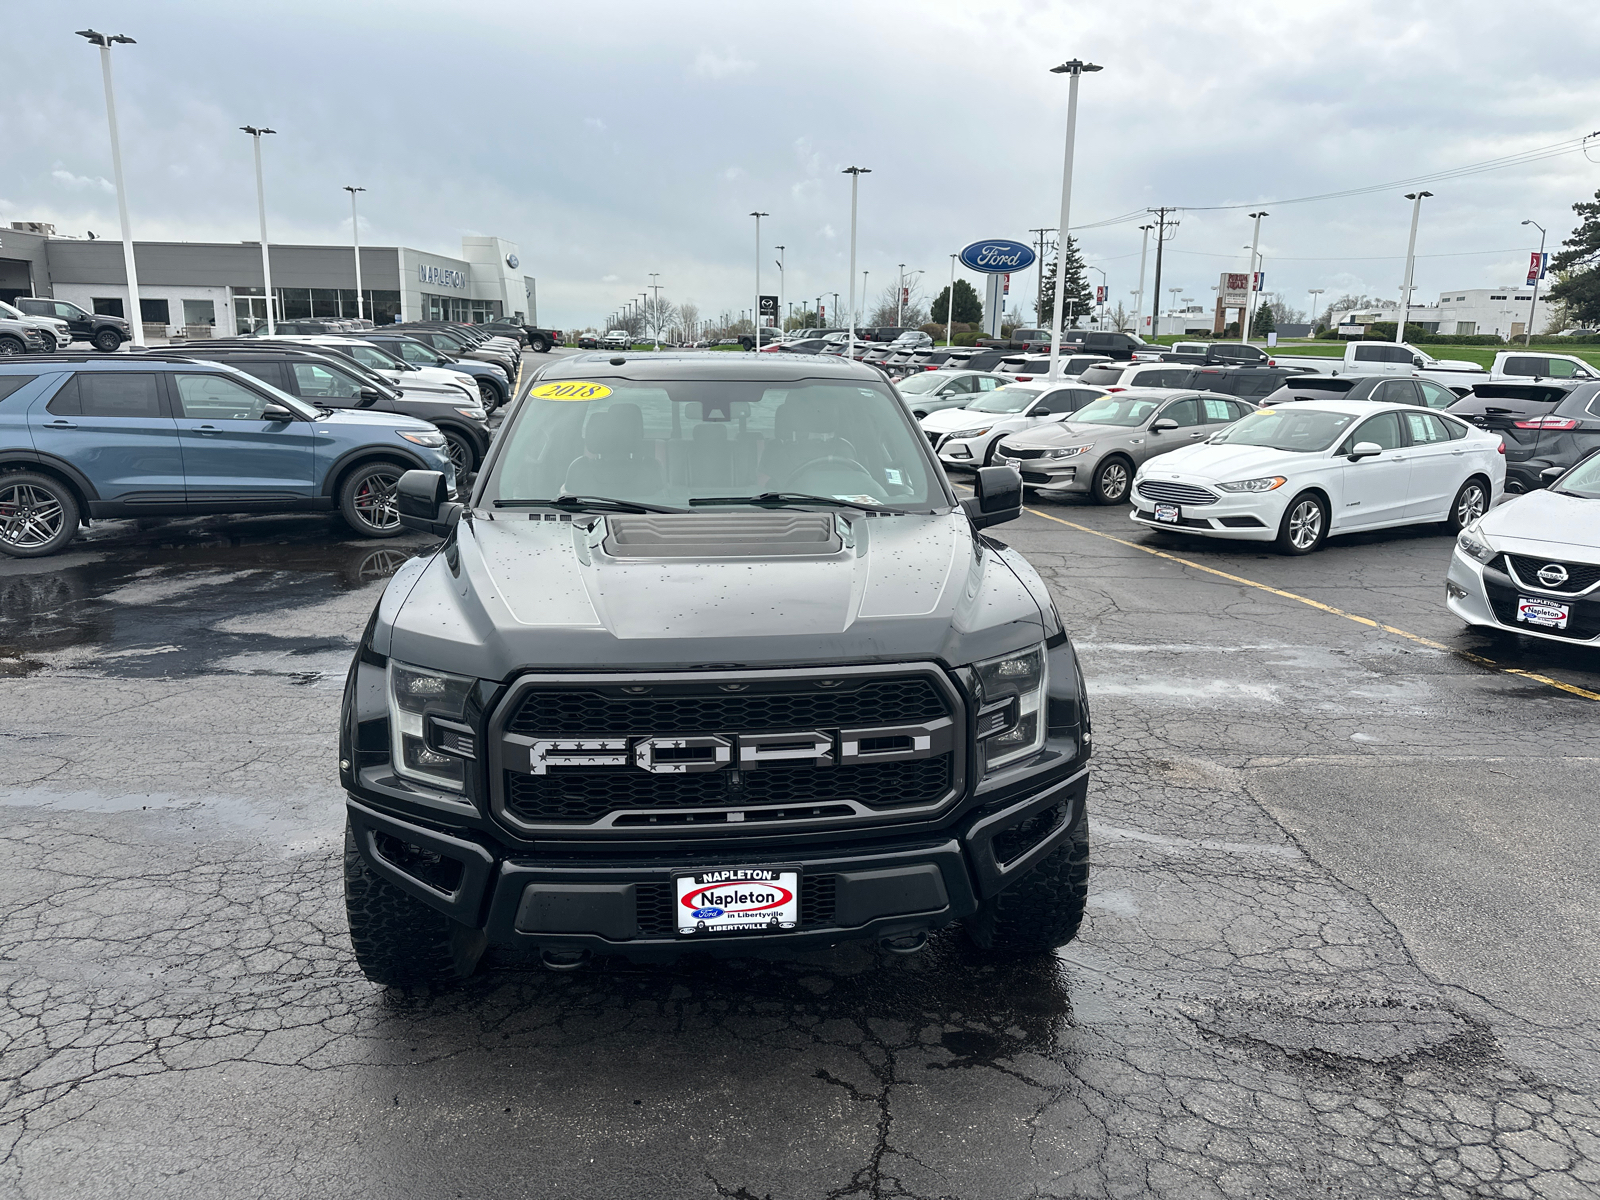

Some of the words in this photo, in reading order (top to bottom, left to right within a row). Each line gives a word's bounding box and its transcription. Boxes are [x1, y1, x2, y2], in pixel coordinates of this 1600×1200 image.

[977, 245, 1021, 266] Ford
[420, 264, 466, 289] NAPLETON
[540, 385, 602, 397] 2018
[1540, 572, 1564, 580] NISSAN
[1528, 606, 1559, 618] Napleton
[529, 727, 931, 775] FORD
[701, 890, 775, 908] Napleton
[698, 908, 719, 918] Ford
[737, 911, 784, 919] Libertyville
[708, 923, 767, 932] LIBERTYVILLE
